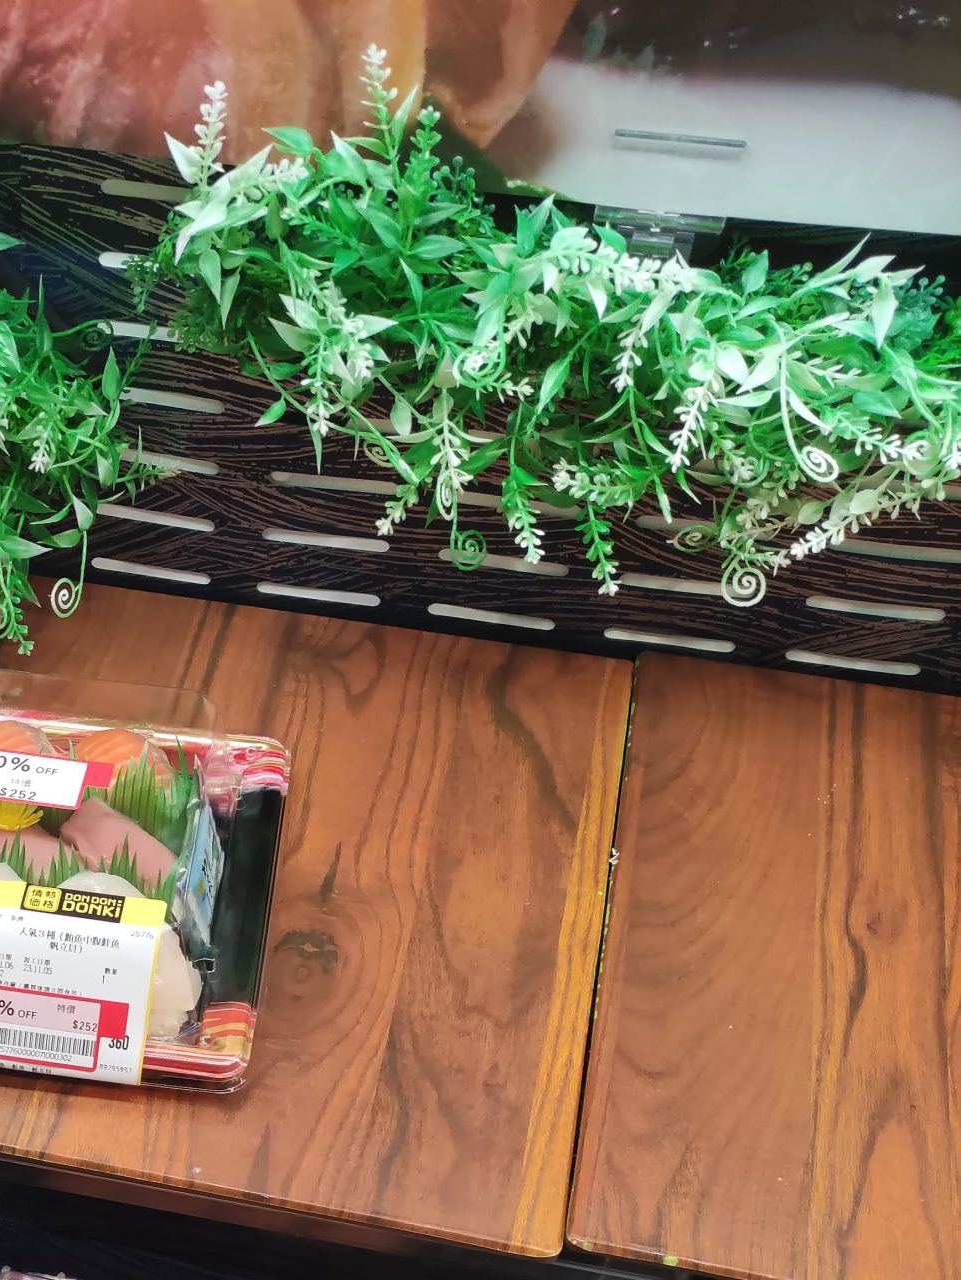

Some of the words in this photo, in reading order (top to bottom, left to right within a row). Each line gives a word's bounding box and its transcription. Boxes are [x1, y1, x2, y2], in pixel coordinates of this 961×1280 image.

[35, 766, 58, 776] OFF
[0, 787, 37, 801] $252
[23, 963, 53, 976] 23.11.05
[18, 1009, 38, 1020] OFF
[72, 1020, 98, 1033] $252
[108, 1036, 130, 1051] 360
